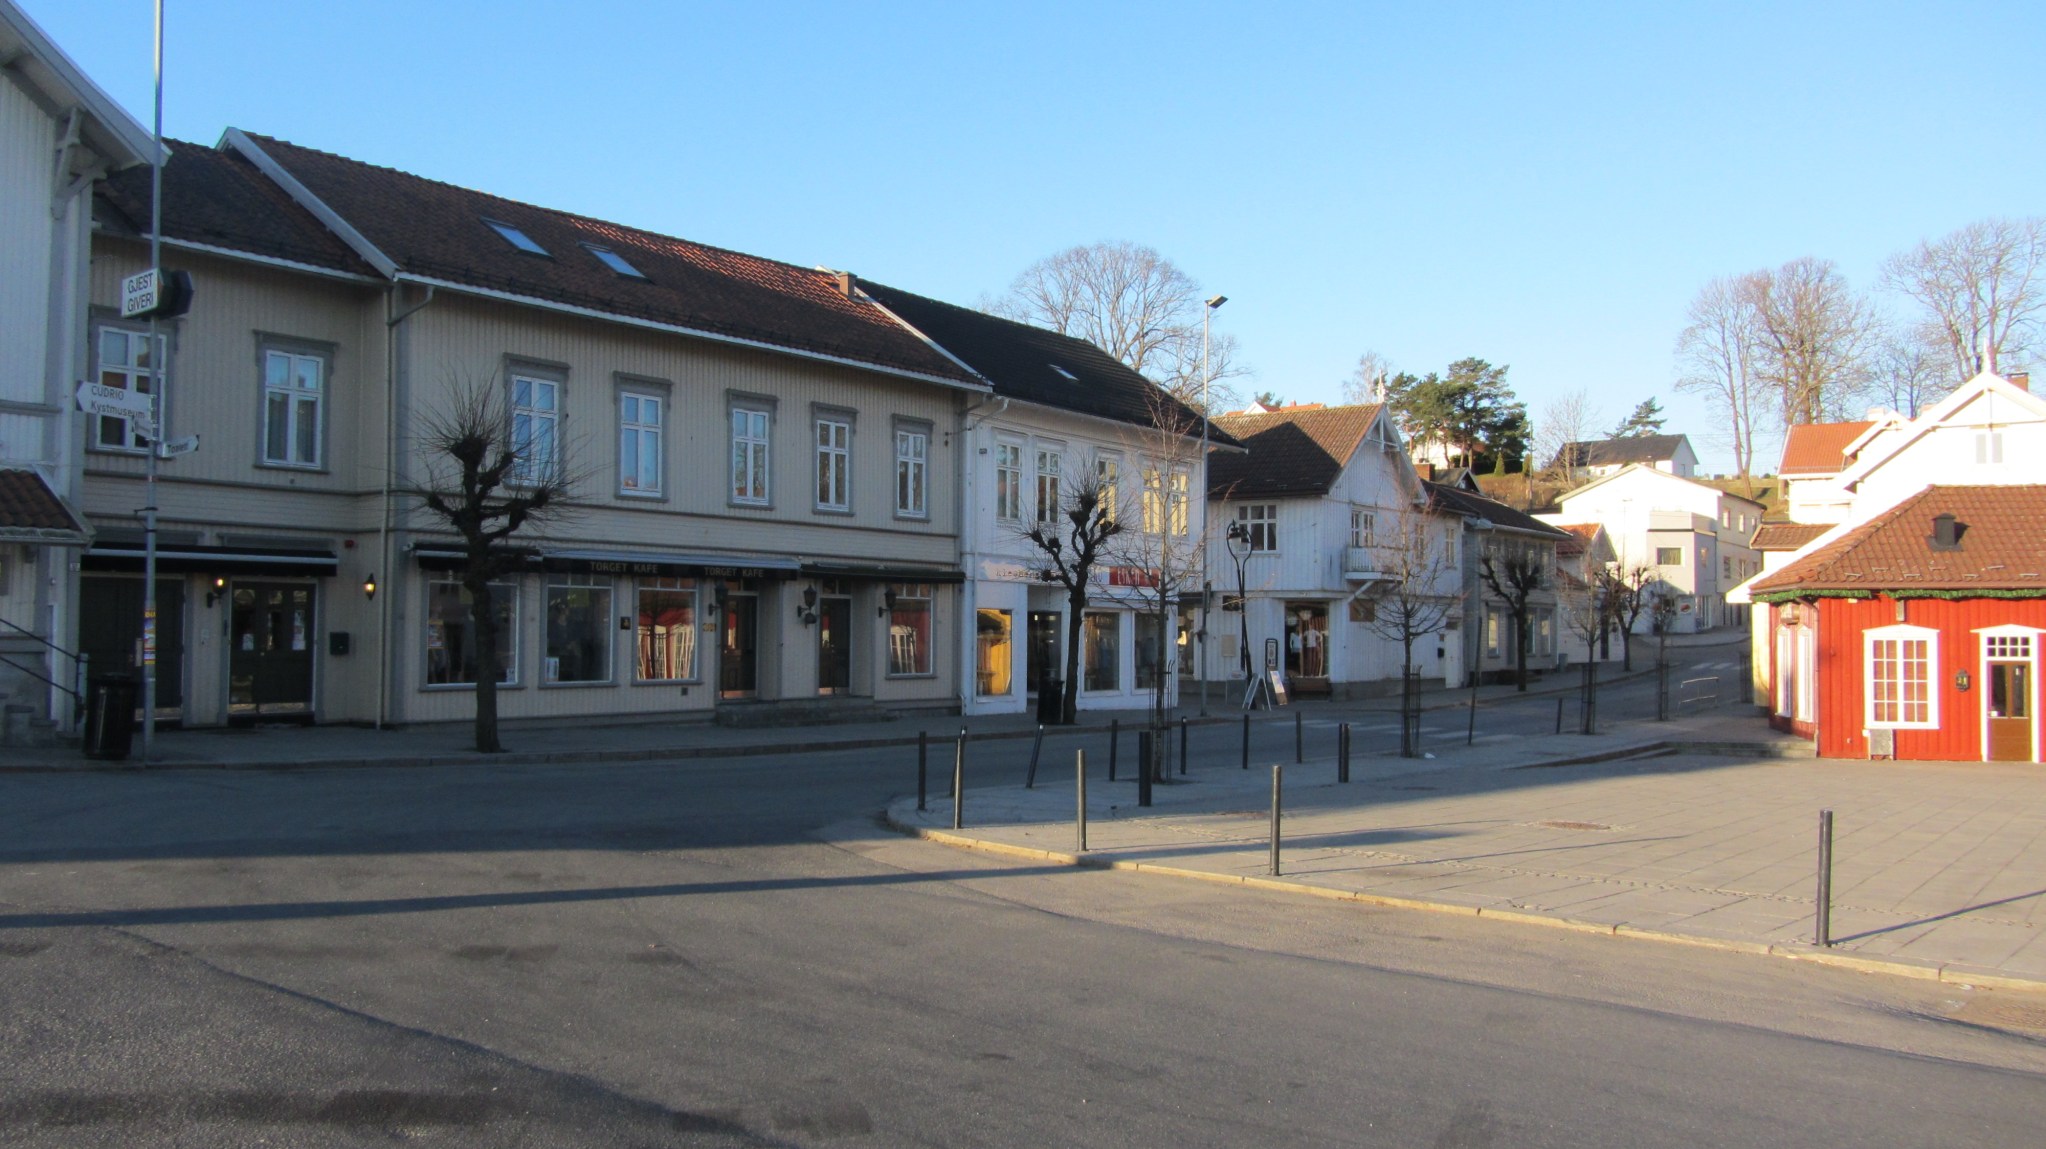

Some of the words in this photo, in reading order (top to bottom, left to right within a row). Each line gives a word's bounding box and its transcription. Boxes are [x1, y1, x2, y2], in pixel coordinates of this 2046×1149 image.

[128, 272, 153, 294] GJEST
[127, 291, 153, 312] GIVERI
[91, 385, 124, 401] CUDRIO
[91, 400, 146, 419] Kystmuseum
[590, 561, 627, 572] TORGET
[633, 563, 659, 574] KAFE
[704, 566, 738, 577] TORGET
[742, 568, 765, 578] KAFE
